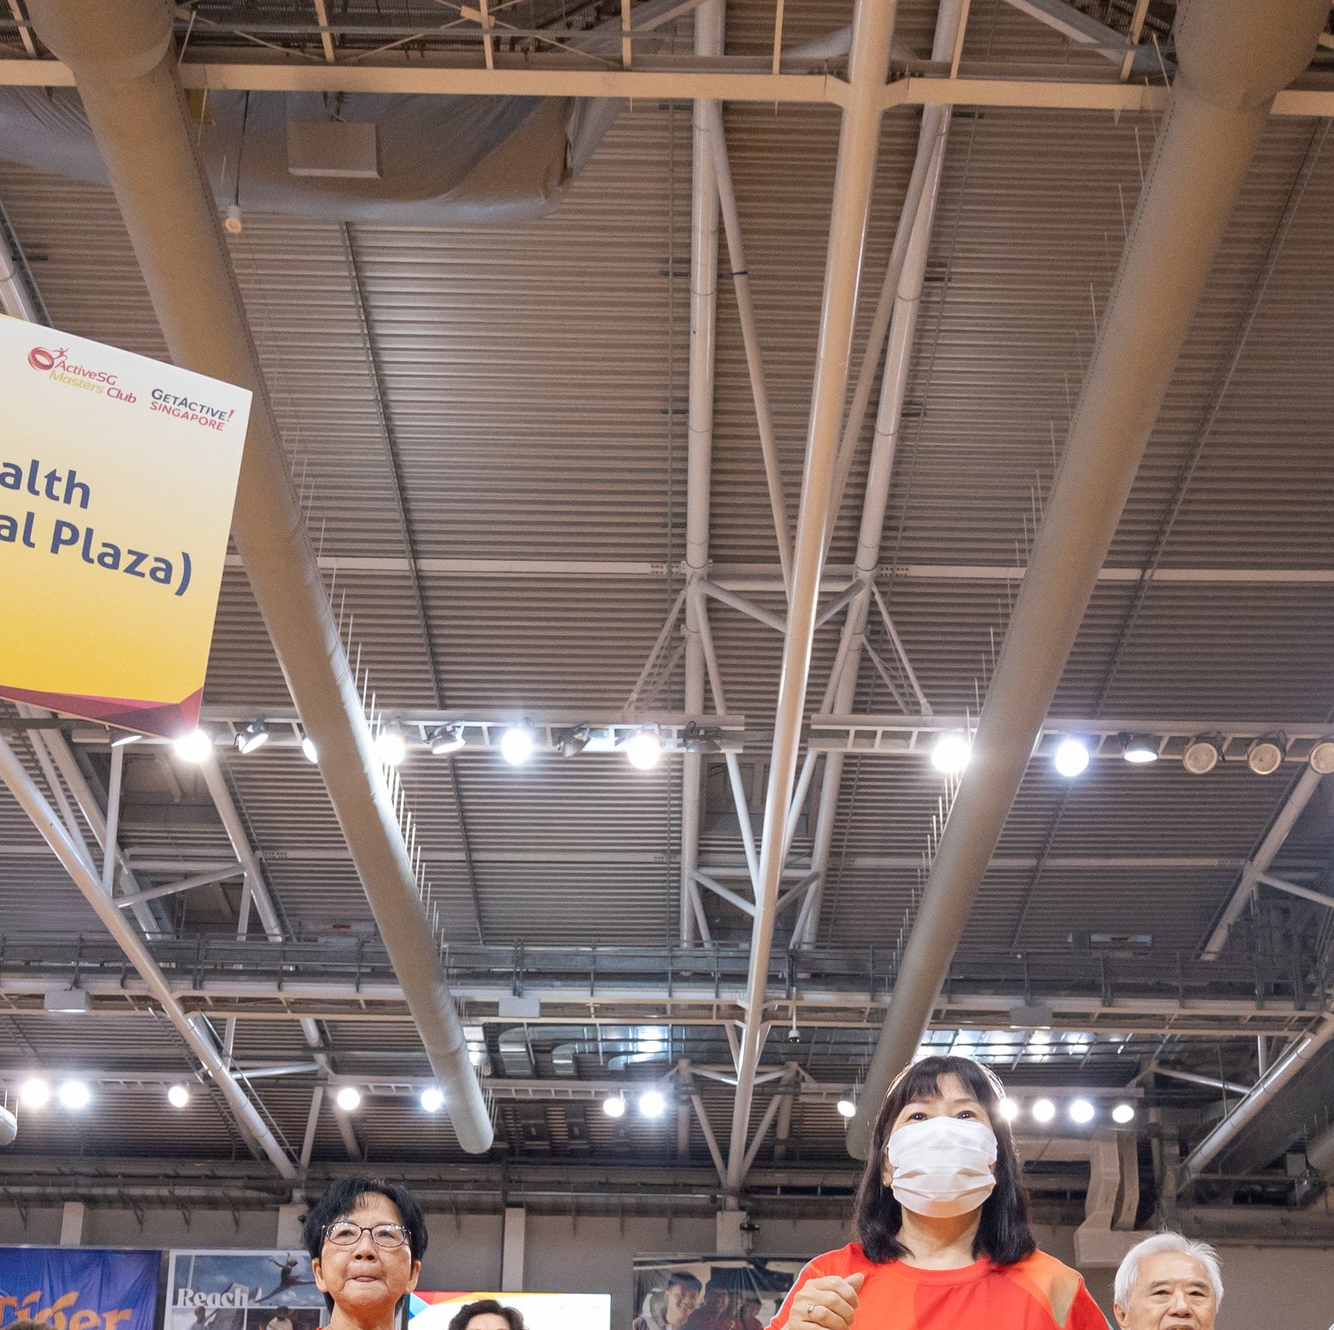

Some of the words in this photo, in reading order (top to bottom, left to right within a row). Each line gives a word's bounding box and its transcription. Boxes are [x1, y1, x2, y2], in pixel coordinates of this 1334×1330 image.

[49, 369, 104, 395] Masters
[106, 387, 137, 404] Club
[54, 360, 119, 386] ActiveSG
[149, 401, 226, 432] SINGAPORE
[50, 518, 193, 597] Plaza)
[177, 1288, 248, 1307] Reach
